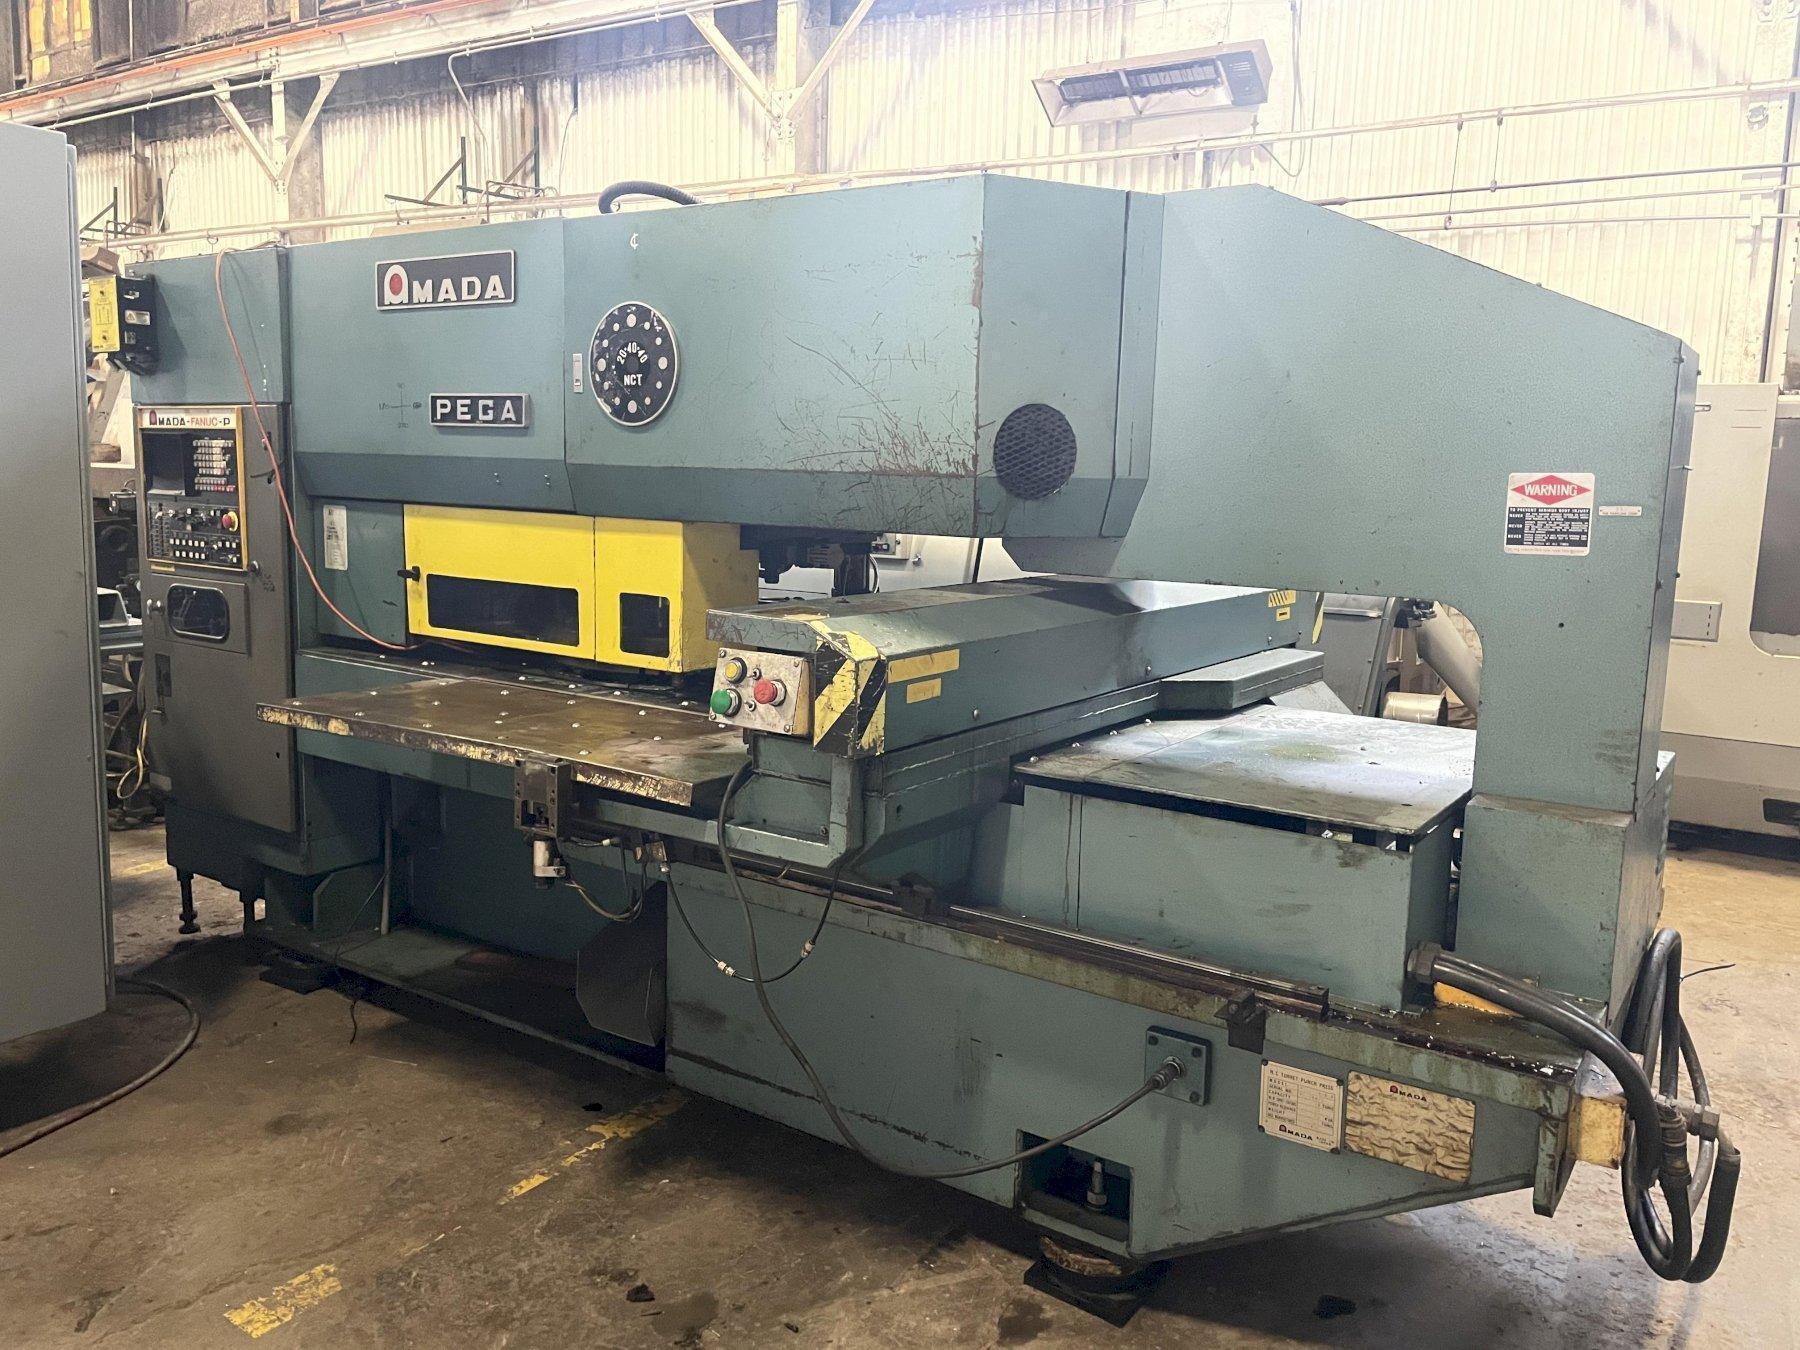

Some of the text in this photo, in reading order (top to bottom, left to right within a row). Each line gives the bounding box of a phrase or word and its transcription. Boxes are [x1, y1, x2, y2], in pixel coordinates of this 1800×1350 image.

[384, 264, 506, 305] AMADA
[623, 373, 643, 386] NCT
[436, 399, 517, 422] PEGA
[1524, 484, 1579, 497] WARNING
[1300, 1077, 1318, 1086] PUNCH
[1319, 1082, 1334, 1091] PRESS
[1390, 1085, 1427, 1102] AMADA
[1279, 1124, 1313, 1141] AMADA
